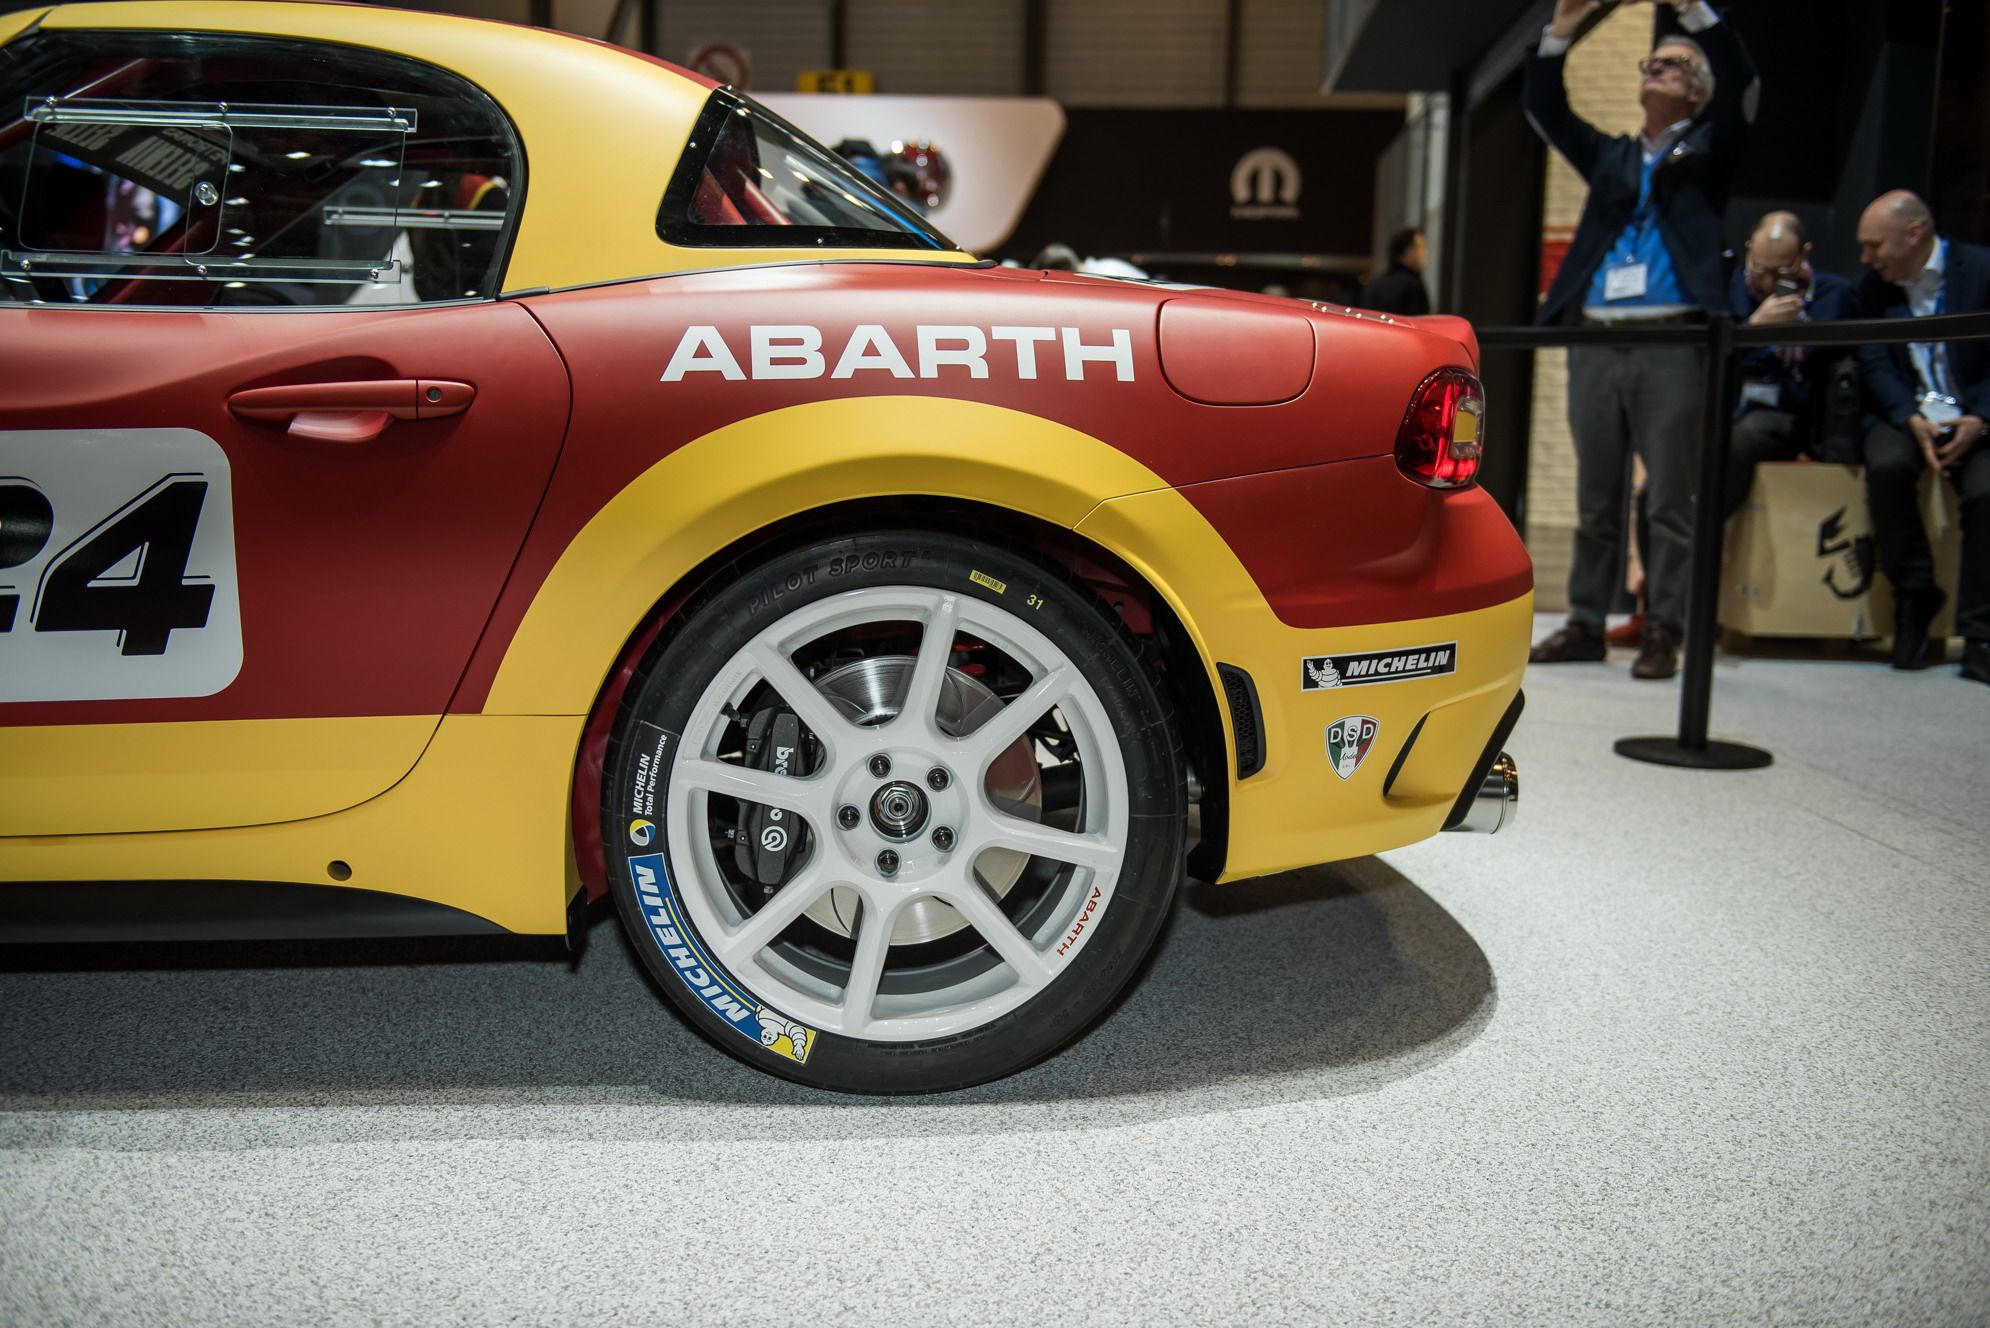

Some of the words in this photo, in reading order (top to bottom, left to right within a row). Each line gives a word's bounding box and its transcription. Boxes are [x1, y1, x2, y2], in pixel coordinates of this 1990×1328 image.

[659, 324, 1136, 383] ABARTH
[748, 565, 819, 615] PILOT
[829, 551, 917, 577] SPORT
[1026, 594, 1044, 610] 31
[1345, 649, 1451, 677] MICHELIN
[1330, 724, 1374, 743] DSD
[633, 753, 651, 815] MICHELIN
[648, 734, 668, 792] Performance
[645, 793, 654, 816] Total
[635, 864, 751, 1023] MICHELIN
[1056, 886, 1101, 956] ABARTH
